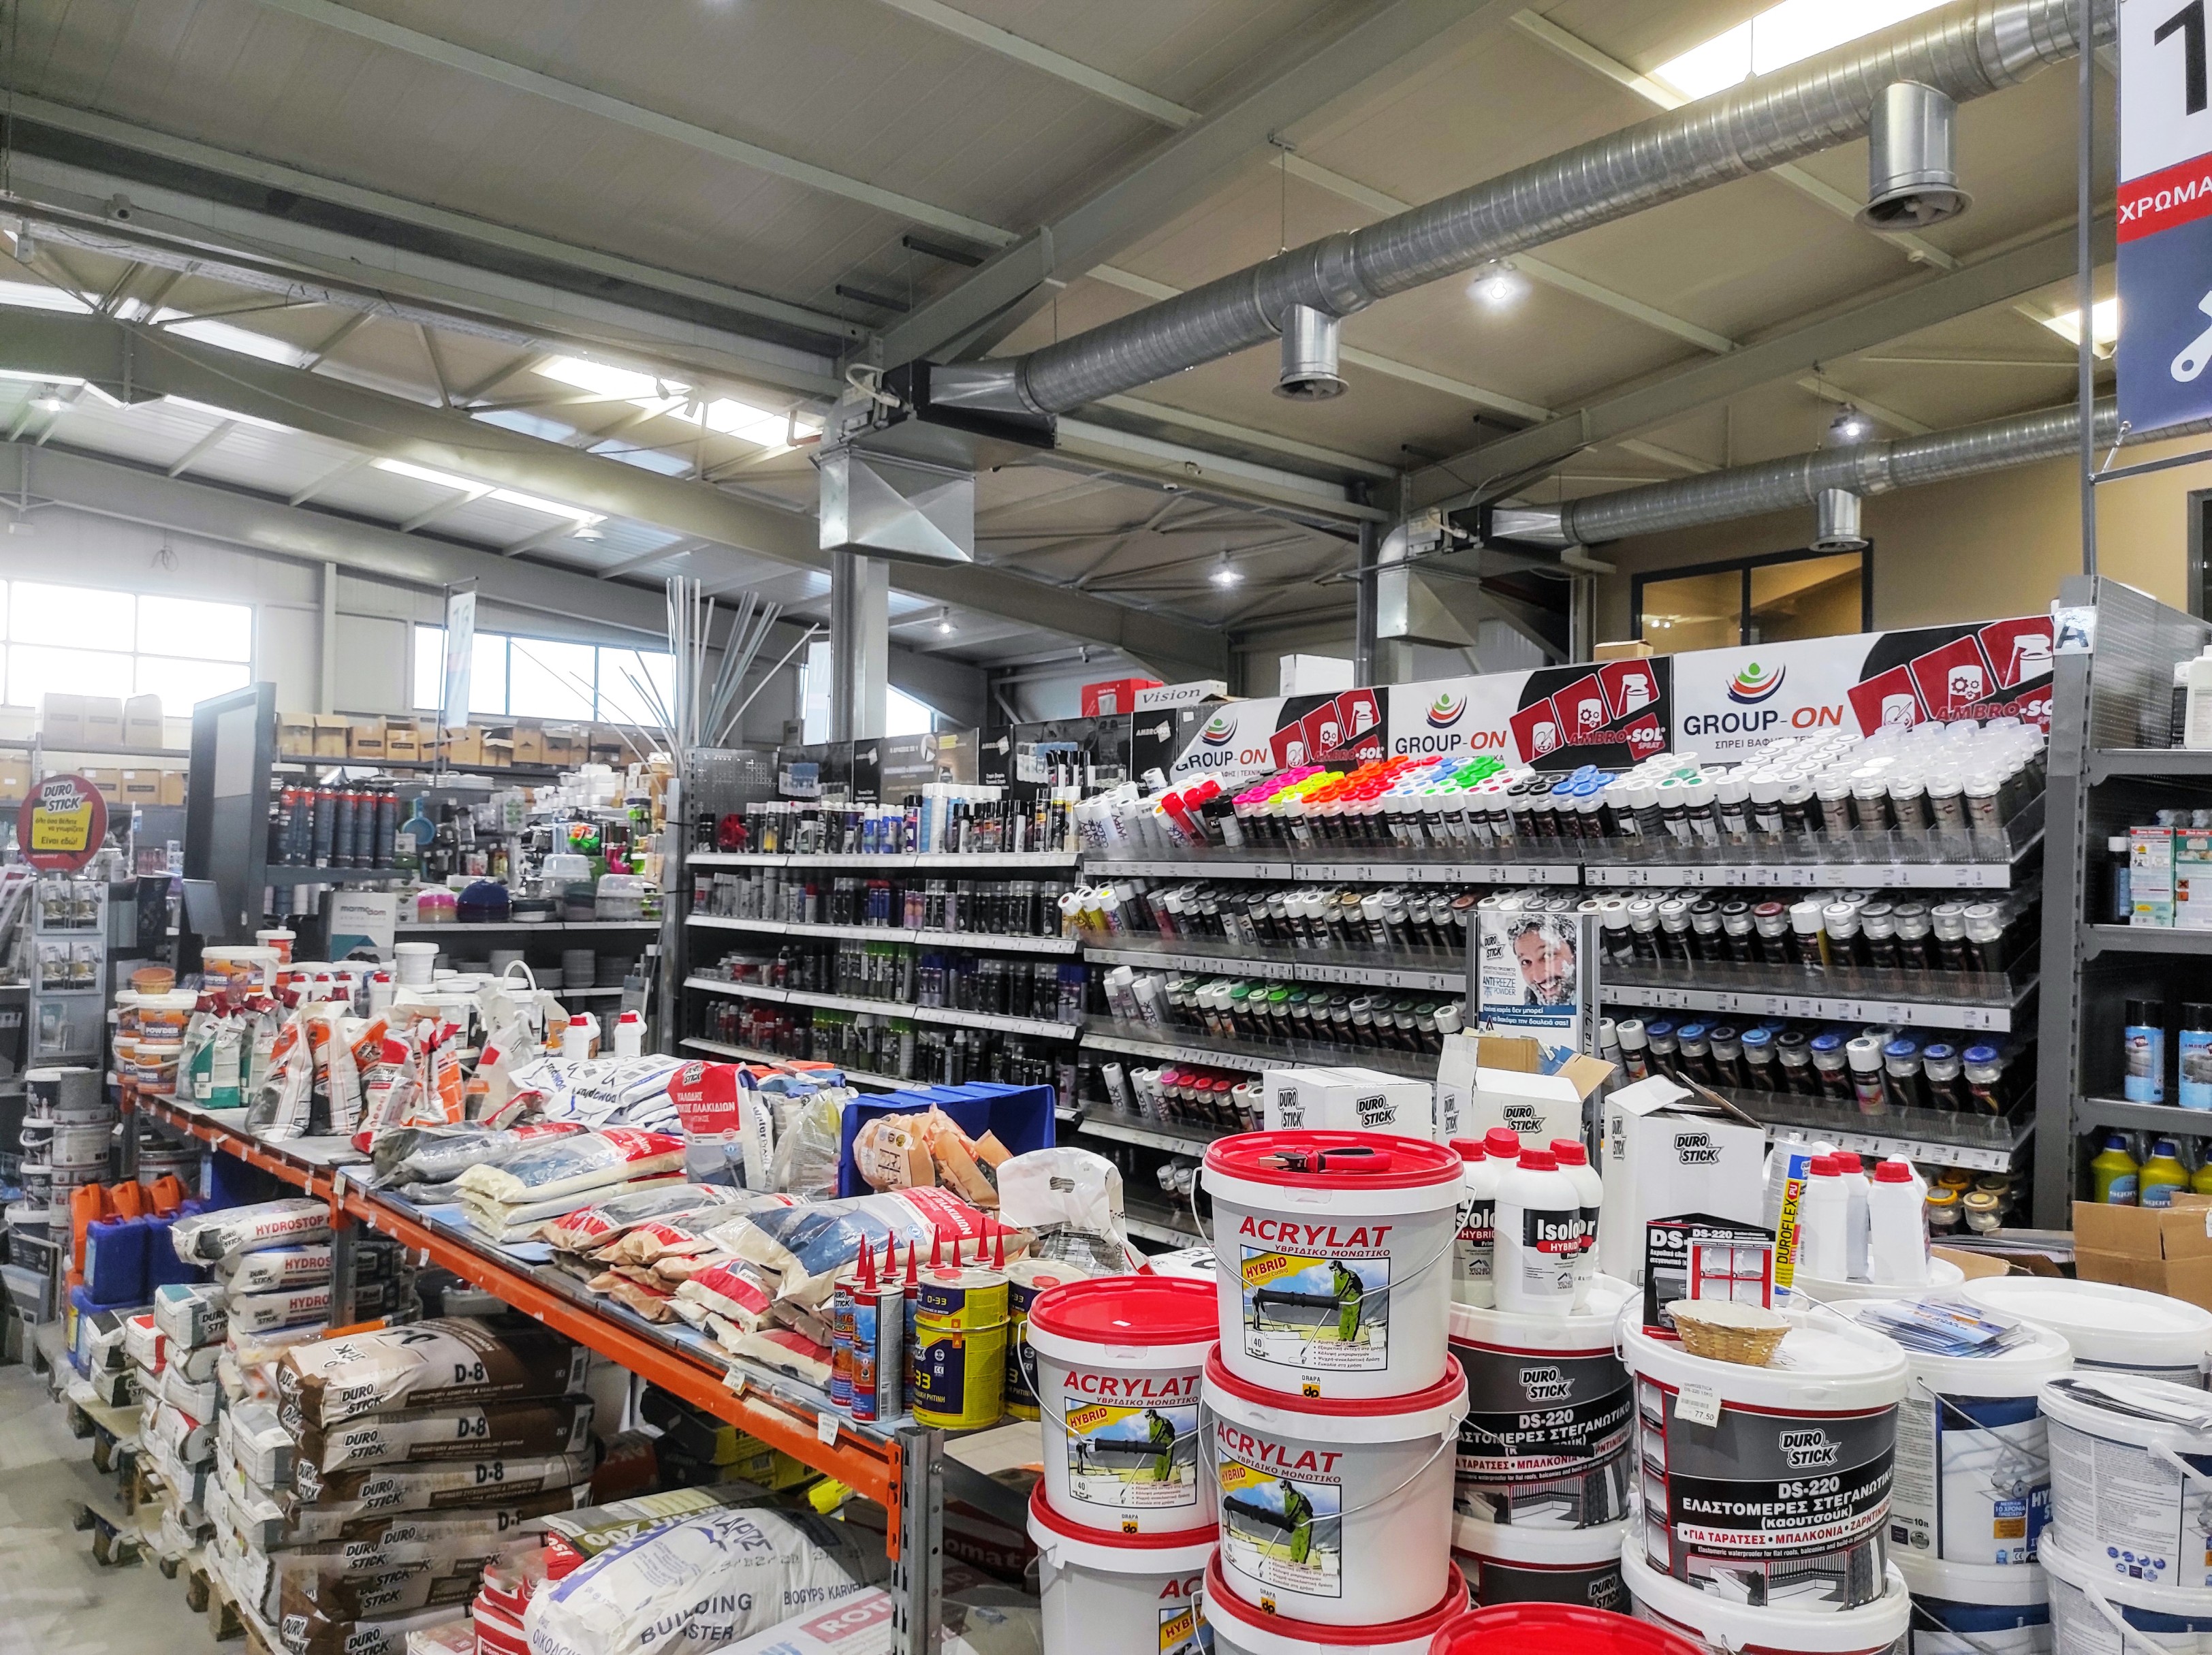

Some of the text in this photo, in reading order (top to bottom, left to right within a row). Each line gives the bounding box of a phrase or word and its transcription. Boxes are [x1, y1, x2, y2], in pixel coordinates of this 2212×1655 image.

[1143, 688, 1201, 704] Vision
[1684, 705, 1844, 736] GROUP-ON
[1395, 730, 1506, 755] GROUP-ON
[1715, 739, 1744, 749] ΣΠΡΕΙ
[1175, 748, 1268, 772] GROUP-ON
[44, 783, 72, 798] DURO
[48, 797, 80, 812] STICK
[1487, 946, 1502, 958] STICK
[1483, 975, 1516, 988] ANTIFREEZE
[693, 1101, 736, 1113] ΠΛΑΚΙΔΙΩΝ
[1279, 1091, 1297, 1109] DURO
[1357, 1097, 1385, 1112] DURO
[1283, 1110, 1303, 1128] STICK
[1363, 1109, 1393, 1125] STICK
[1505, 1107, 1532, 1119] DURO
[1509, 1120, 1540, 1132] STICK
[1677, 1135, 1707, 1148] DURO
[1682, 1149, 1718, 1163] STICK
[1788, 1184, 1798, 1197] PU
[255, 1214, 324, 1235] HYDROSTOP
[1239, 1216, 1393, 1248] ACRYLAT
[1776, 1199, 1798, 1264] DUROFLEX
[219, 1229, 236, 1242] DURO
[223, 1235, 244, 1248] STICK
[1692, 1229, 1733, 1239] DS-220
[1275, 1244, 1391, 1257] ΥΒΡΙΔΙΚΟ ΜΟΝΩΤΙΚΟ
[1550, 1242, 1578, 1252] HYBRID
[249, 1268, 268, 1278] DURO
[1246, 1257, 1287, 1278] HYBRID
[252, 1275, 274, 1286] STICK
[1253, 1338, 1263, 1349] 40
[1063, 1370, 1201, 1398] ACRYLAT
[1301, 1374, 1321, 1383] DRAPA
[1521, 1369, 1557, 1383] DURO
[342, 1383, 374, 1402] DURO
[926, 1393, 946, 1404] ΡΗΤΙΝΗ
[1530, 1383, 1568, 1398] STICK
[346, 1394, 384, 1415] STICK
[1096, 1396, 1199, 1406] ΥΒΡΙΔΙΚΟ ΜΟΝΩΤΙΚΟ
[1070, 1407, 1108, 1428] HYBRID
[1519, 1408, 1574, 1429] DS-220
[1549, 1400, 1631, 1440] ΣΤΕΓΑΝΩΤΙΚΟ
[345, 1430, 378, 1449] DURO
[1217, 1420, 1343, 1473] ACRYLAT
[1783, 1432, 1822, 1448] DURO
[349, 1442, 386, 1459] STICK
[1792, 1447, 1833, 1464] STICK
[298, 1462, 316, 1481] DURO
[1237, 1454, 1342, 1483] ΥΒΡΙΔΙΚΟ ΜΟΝΩΤΙΚΟ
[300, 1483, 319, 1500] STICK
[362, 1479, 394, 1497] DURO
[1077, 1481, 1086, 1491] 40
[1778, 1476, 1840, 1500] DS-220
[365, 1491, 402, 1509] STICK
[1682, 1497, 1808, 1517] ΕΛΑΣΤΟΜΕΡΕΣ
[1761, 1504, 1853, 1530] (καουτσούκ)
[383, 1527, 416, 1545] DURO
[1689, 1525, 1843, 1545] ΓΙΑ ΤΑΡΑΤΣΕΣ ΜΠΑΛΚΟΝΙΑ
[345, 1543, 379, 1557] DURO
[1698, 1546, 1727, 1556] Elastomeric
[1728, 1548, 1763, 1558] waterproofer
[1763, 1549, 1772, 1557] for
[1773, 1548, 1783, 1557] flat
[1783, 1547, 1799, 1556] roofs,
[1800, 1545, 1826, 1555] balconies
[1826, 1541, 1835, 1551] and
[349, 1554, 386, 1569] STICK
[364, 1590, 400, 1609] STICK
[784, 1587, 825, 1605] BIOGYPS
[283, 1617, 304, 1636] DURO
[348, 1629, 381, 1649] DURO
